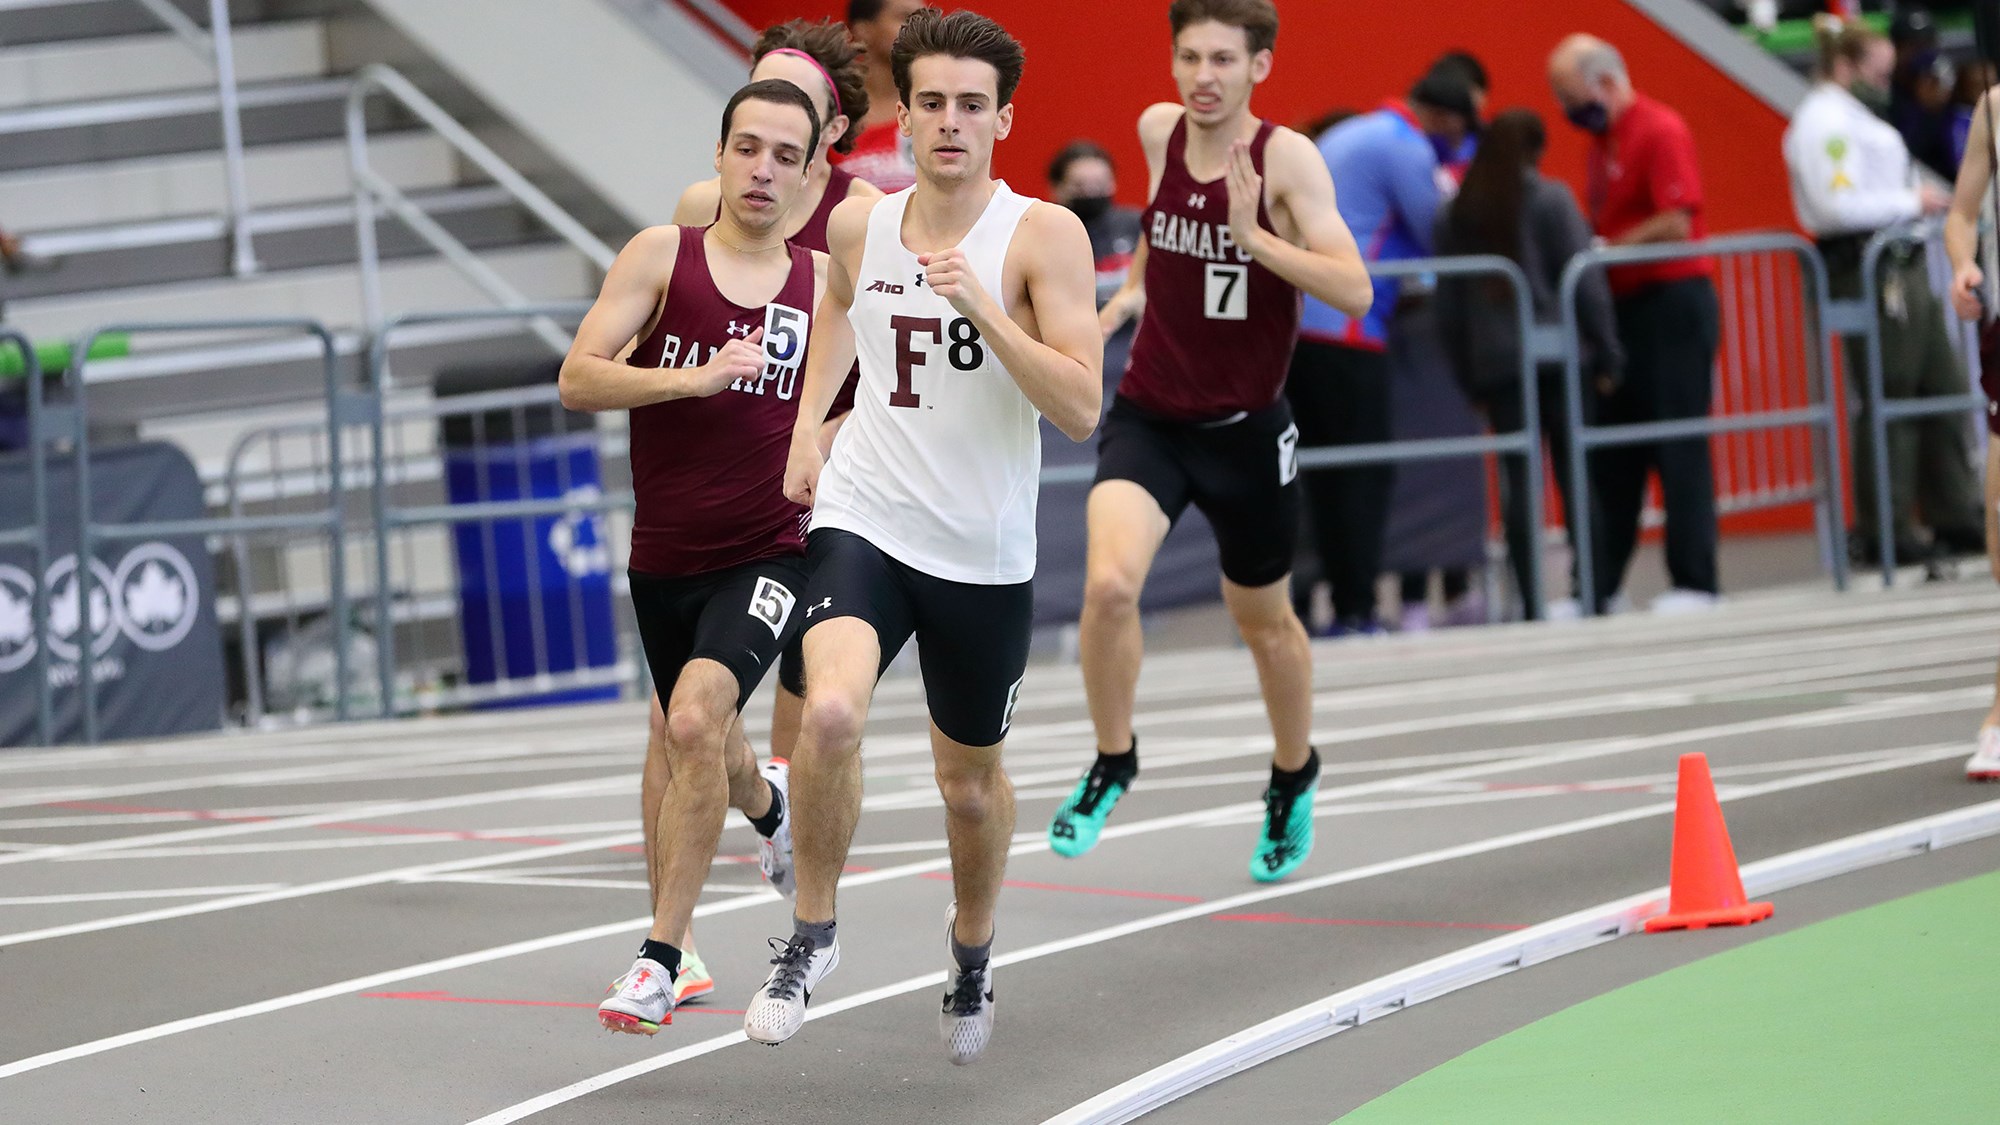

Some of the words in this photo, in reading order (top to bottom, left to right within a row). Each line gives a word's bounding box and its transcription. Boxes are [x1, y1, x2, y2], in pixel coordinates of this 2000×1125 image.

[865, 280, 904, 295] A10
[1213, 270, 1239, 313] 7
[766, 308, 798, 361] 5
[948, 317, 984, 371] 8
[659, 334, 797, 400] RAPO
[889, 315, 942, 408] F
[756, 582, 788, 625] 5
